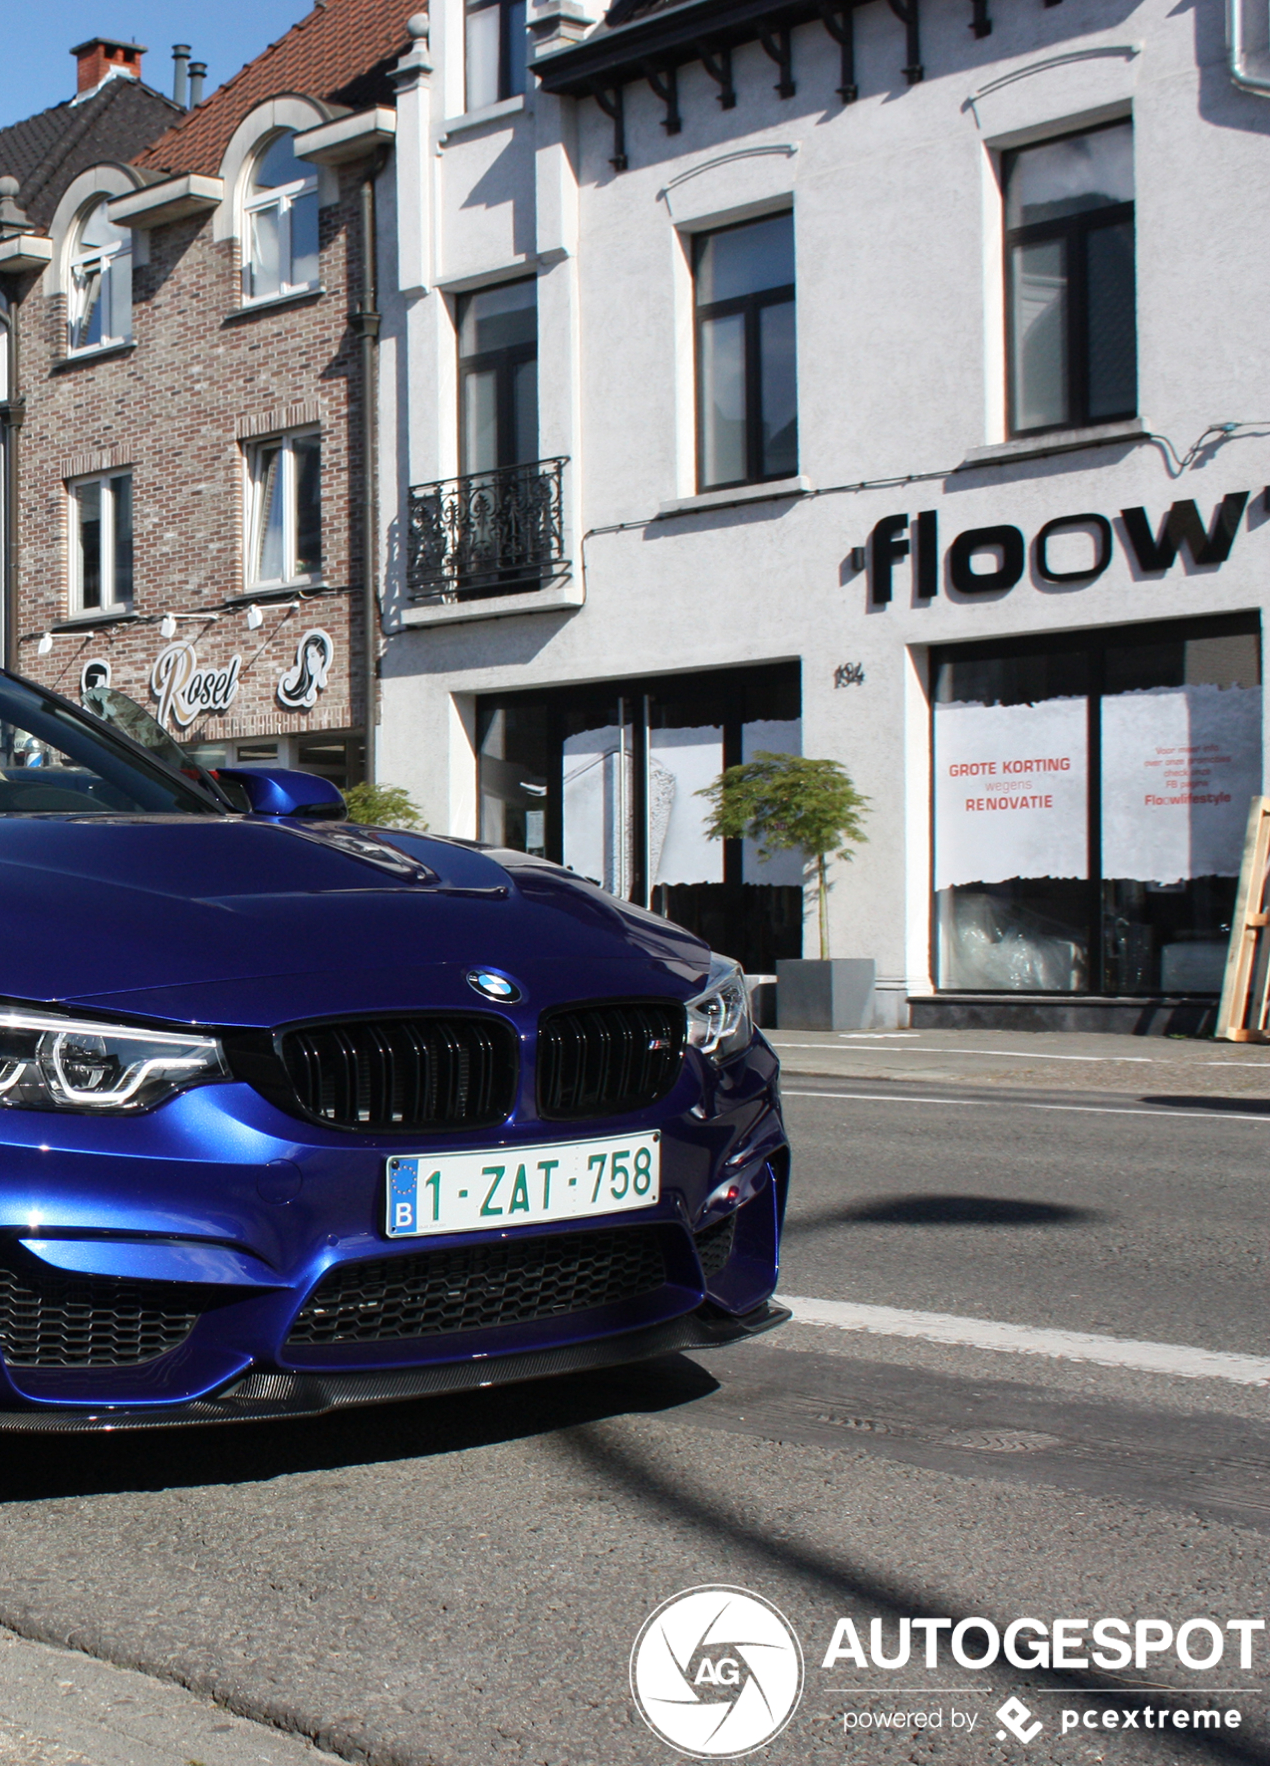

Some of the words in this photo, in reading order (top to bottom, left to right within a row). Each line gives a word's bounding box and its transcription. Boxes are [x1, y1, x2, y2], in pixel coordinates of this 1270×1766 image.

[872, 491, 1250, 604] floow
[152, 642, 240, 727] Rosel
[949, 762, 997, 777] GROTE
[1003, 757, 1071, 774] KORTING
[985, 780, 1033, 794] wegens
[966, 795, 1053, 812] RENOVATIE
[395, 1202, 413, 1228] B
